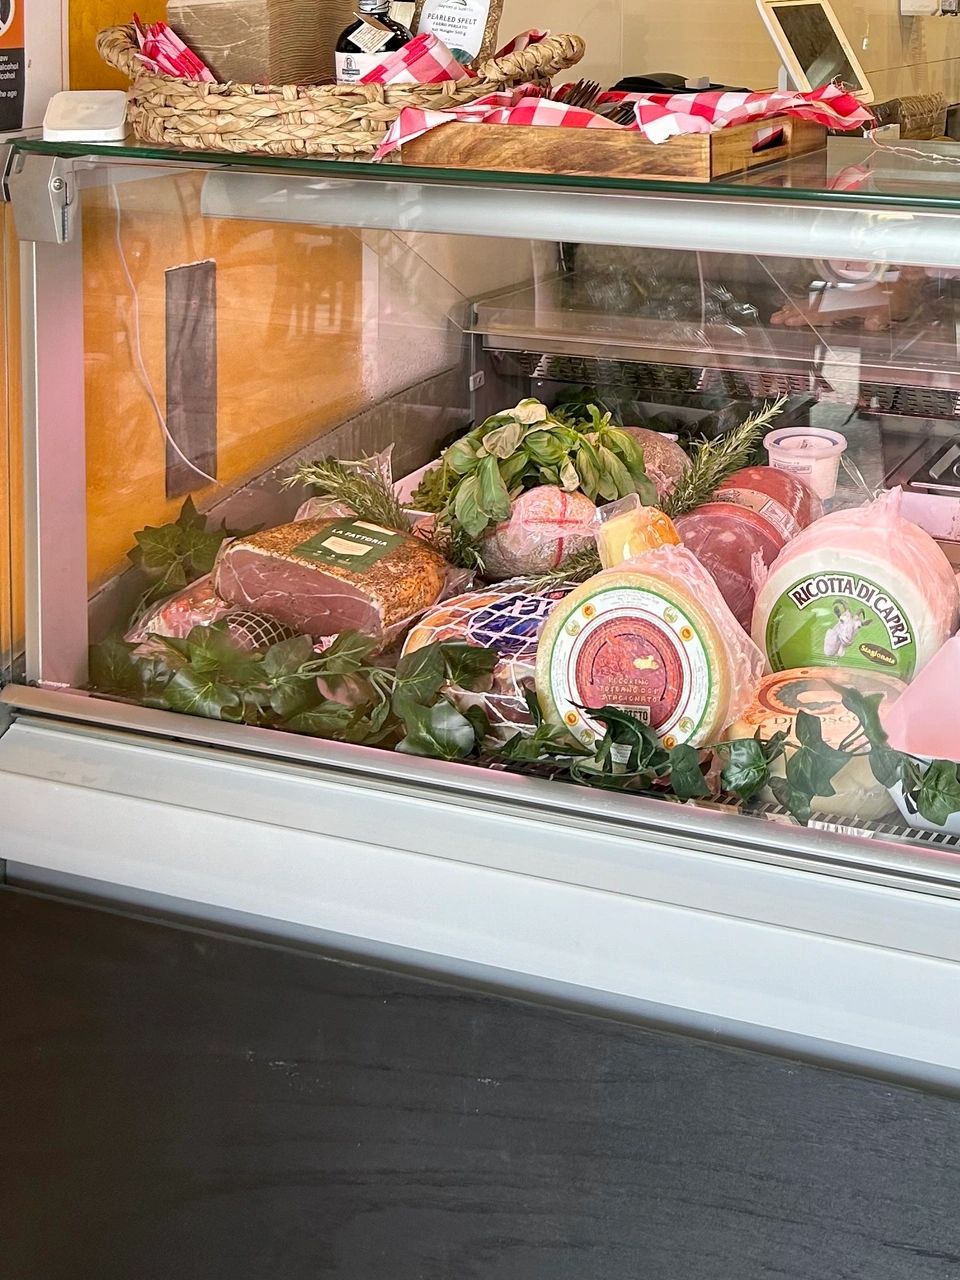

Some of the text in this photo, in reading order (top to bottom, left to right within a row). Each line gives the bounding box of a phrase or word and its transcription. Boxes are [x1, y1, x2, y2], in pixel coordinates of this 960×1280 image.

[427, 12, 477, 25] PEARLED SPELT
[345, 532, 388, 547] FATTORIA
[791, 577, 909, 646] RICOTTA DI CAPRA
[860, 644, 897, 665] Stagionata
